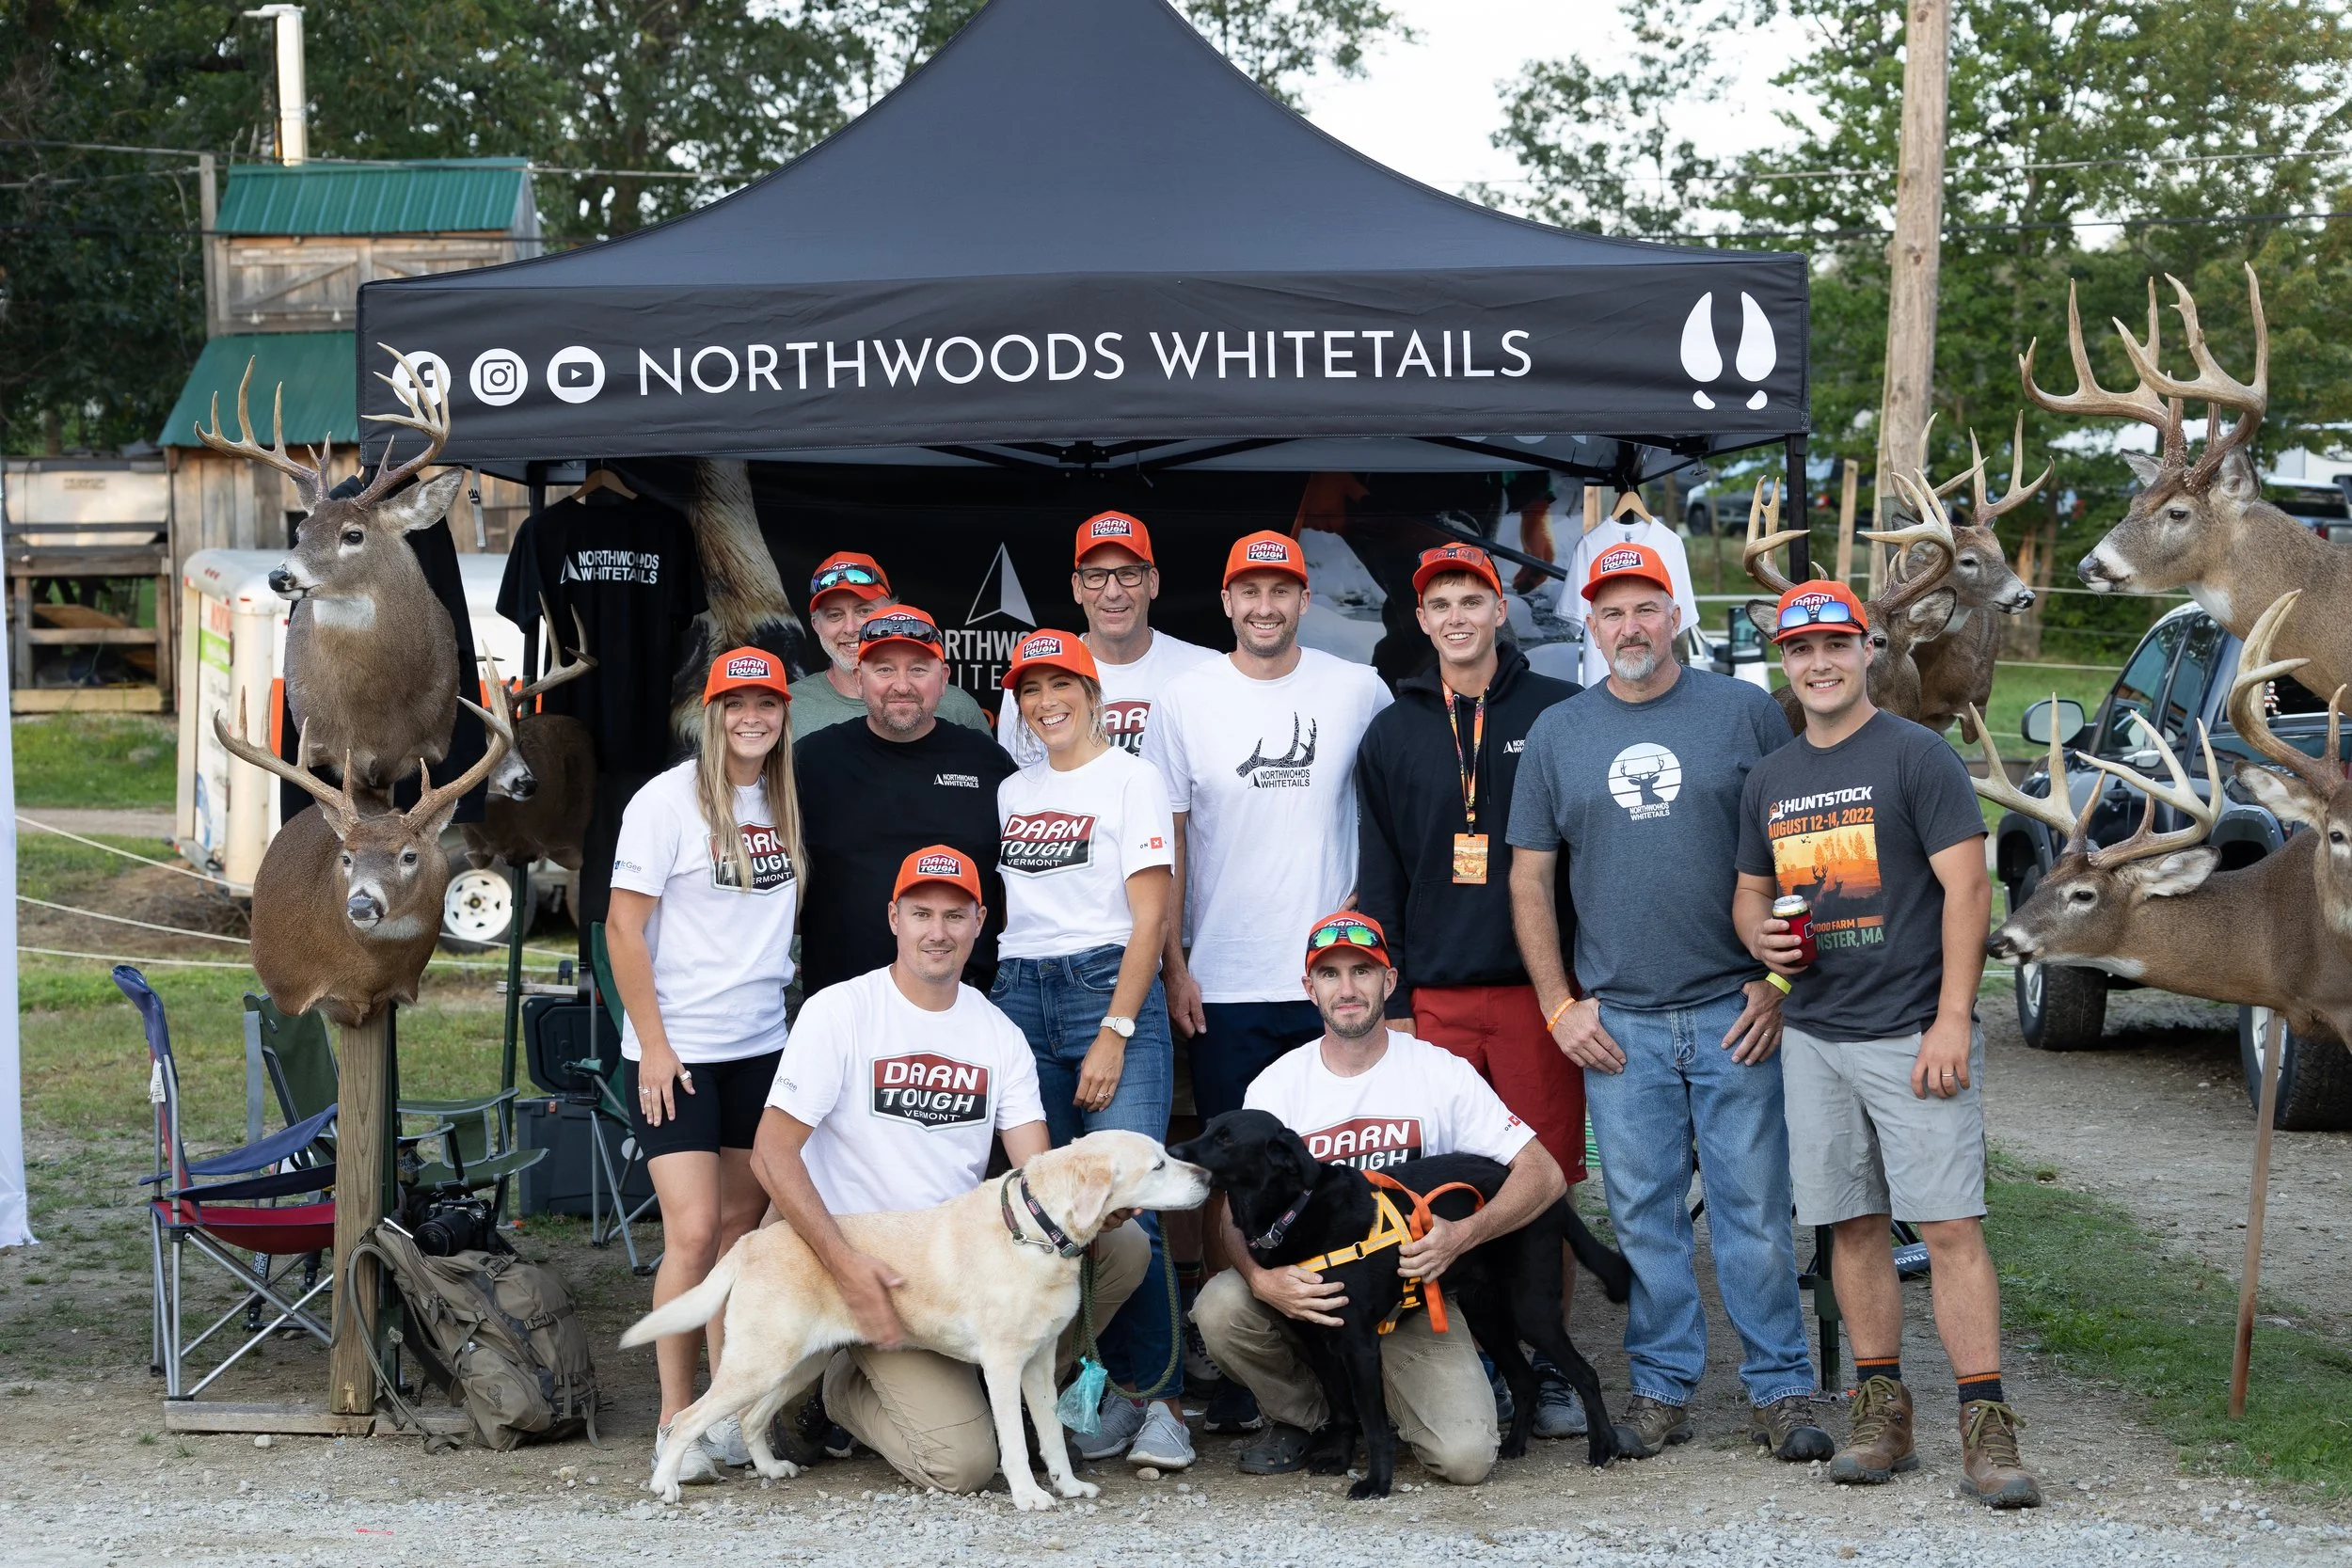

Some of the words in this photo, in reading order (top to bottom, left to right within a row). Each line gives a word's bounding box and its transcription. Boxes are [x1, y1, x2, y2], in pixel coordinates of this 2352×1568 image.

[639, 332, 1125, 396] NORTHWOODS
[1150, 329, 1533, 379] WHITETAILS
[1094, 526, 1127, 534] TOUGH
[1095, 520, 1127, 529] DARN
[1251, 544, 1283, 552] DARN
[1604, 552, 1638, 564] DARN
[1603, 560, 1637, 570] TOUGH
[580, 566, 658, 584] WHITETAILS
[1024, 645, 1057, 657] TOUGH
[1025, 639, 1057, 651] DARN
[731, 659, 765, 669] DARN
[729, 667, 764, 675] TOUGH
[1261, 779, 1311, 788] WHITETAILS
[1784, 785, 1873, 814] HUNTSTOCK
[1630, 809, 1671, 821] WHITETAILS
[1003, 816, 1089, 840] DARN
[1768, 816, 1808, 839] AUGUST
[1810, 811, 1839, 832] 12-14,
[1841, 806, 1875, 825] 2022
[741, 830, 785, 854] ARN
[1001, 840, 1077, 857] TOUGH
[922, 857, 957, 866] DARN
[1007, 858, 1062, 866] VERMONT
[753, 872, 791, 885] ERMONT
[1832, 918, 1855, 930] FARM
[1861, 927, 1884, 945] MA
[883, 1062, 979, 1091] DARN
[882, 1088, 976, 1113] TOUGH
[904, 1110, 960, 1122] VERMONT
[1309, 1121, 1410, 1159] DARN
